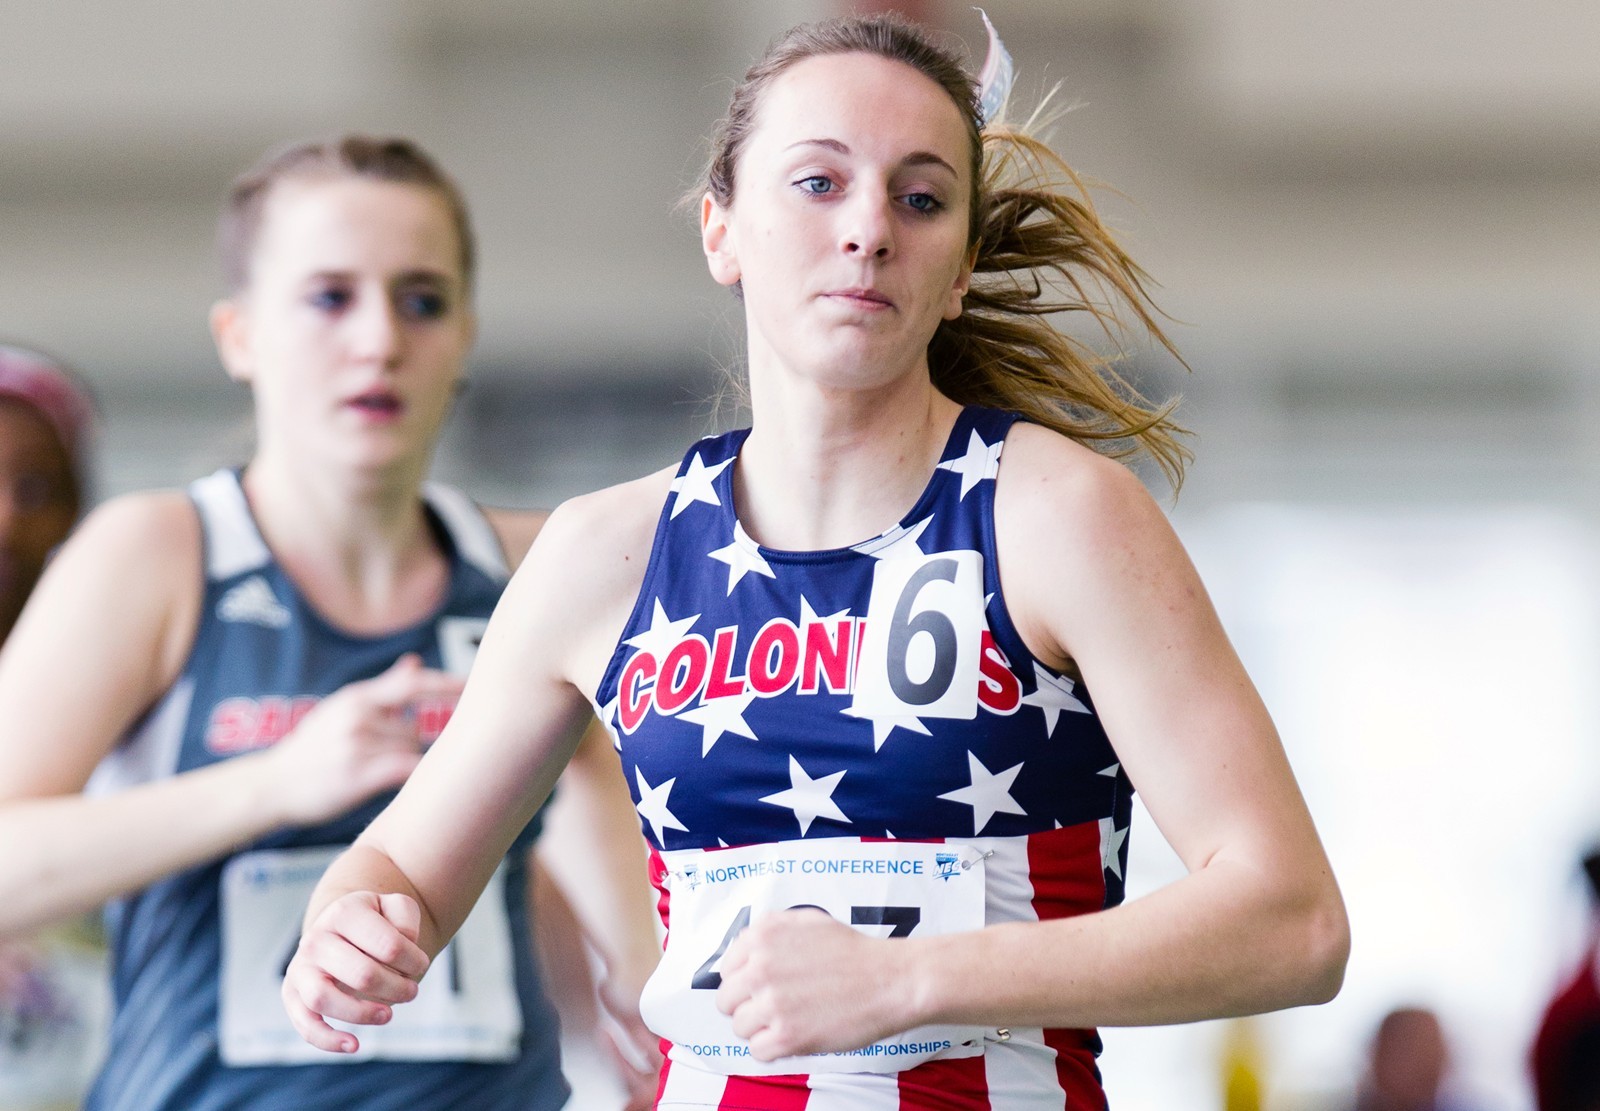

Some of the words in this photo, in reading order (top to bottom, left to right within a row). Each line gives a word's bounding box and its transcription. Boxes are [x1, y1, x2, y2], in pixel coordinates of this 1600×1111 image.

[886, 558, 960, 706] 6
[617, 616, 1022, 735] COLONS
[705, 859, 796, 884] NORTHEAST
[801, 859, 924, 875] CONFERENCE
[725, 1044, 752, 1057] TRA
